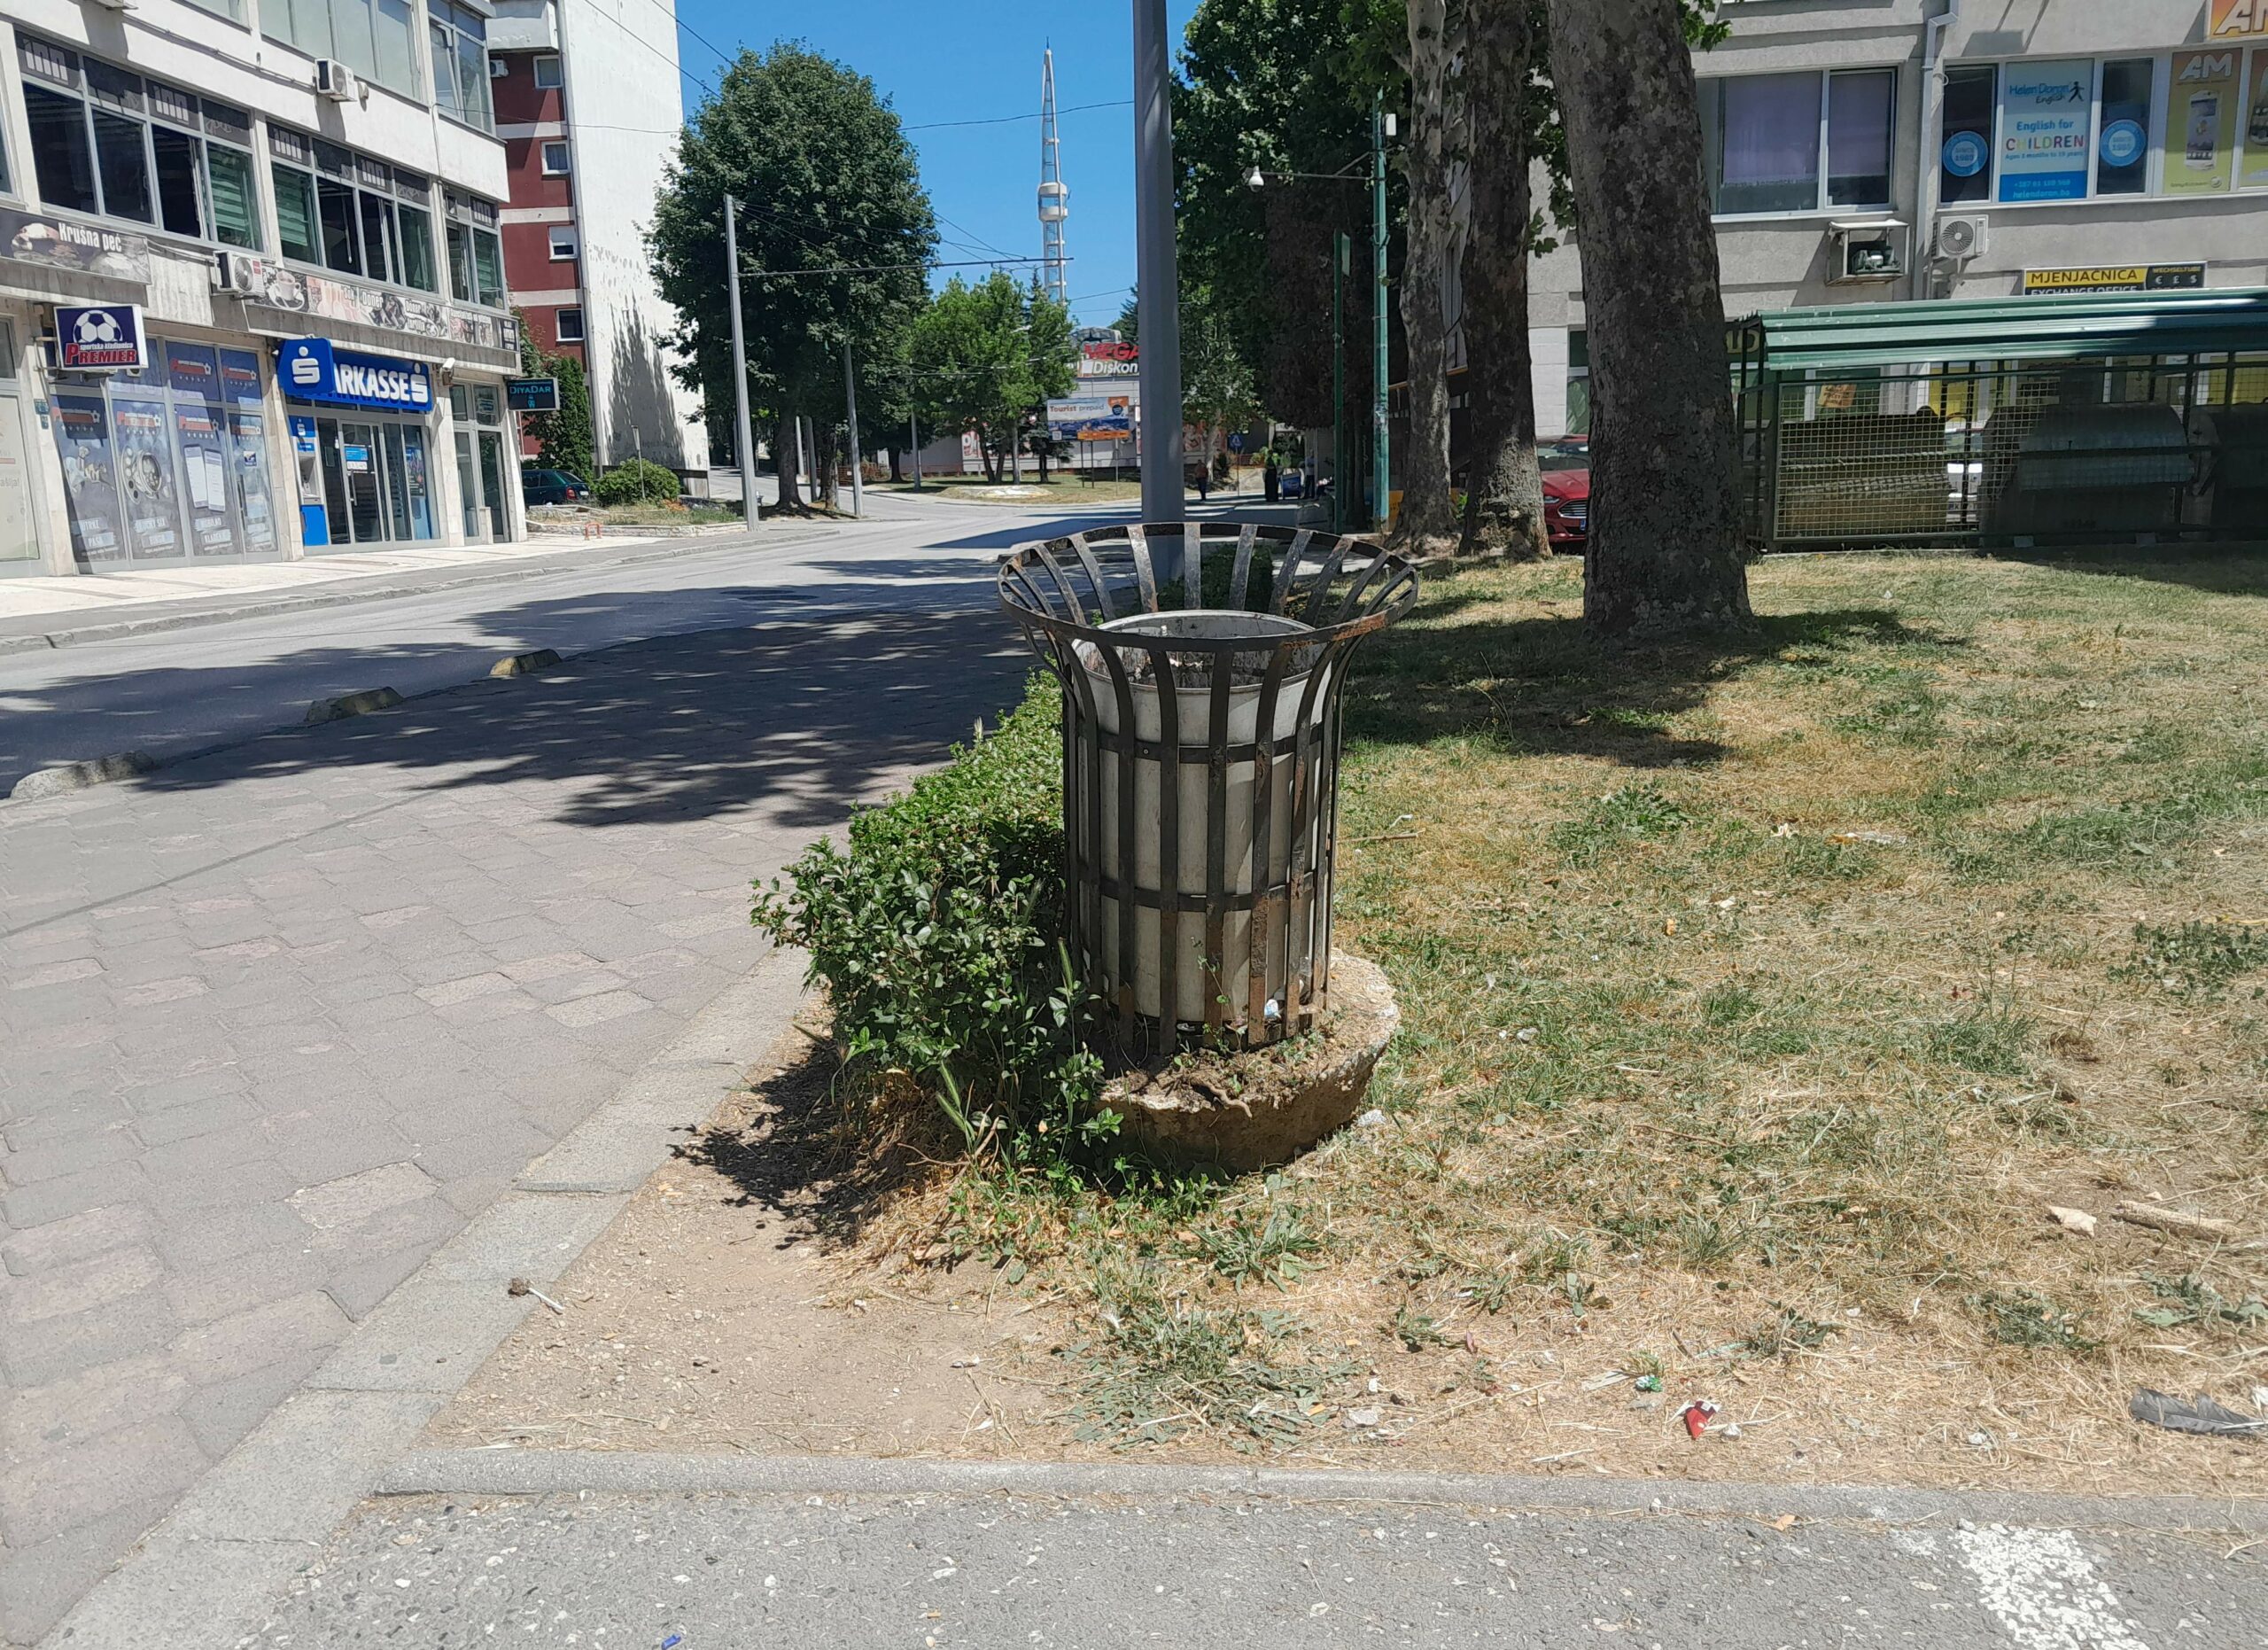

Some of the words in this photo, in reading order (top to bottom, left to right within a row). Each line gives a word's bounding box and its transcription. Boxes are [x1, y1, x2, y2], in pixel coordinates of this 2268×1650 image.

[2179, 53, 2233, 81] AM
[2016, 121, 2055, 133] English
[2059, 119, 2074, 129] for
[2006, 135, 2084, 151] CHILDREN
[58, 222, 100, 248] Krušna
[102, 233, 121, 253] peć
[2031, 269, 2137, 284] MJENJAČNICA
[66, 343, 136, 365] PREMIER
